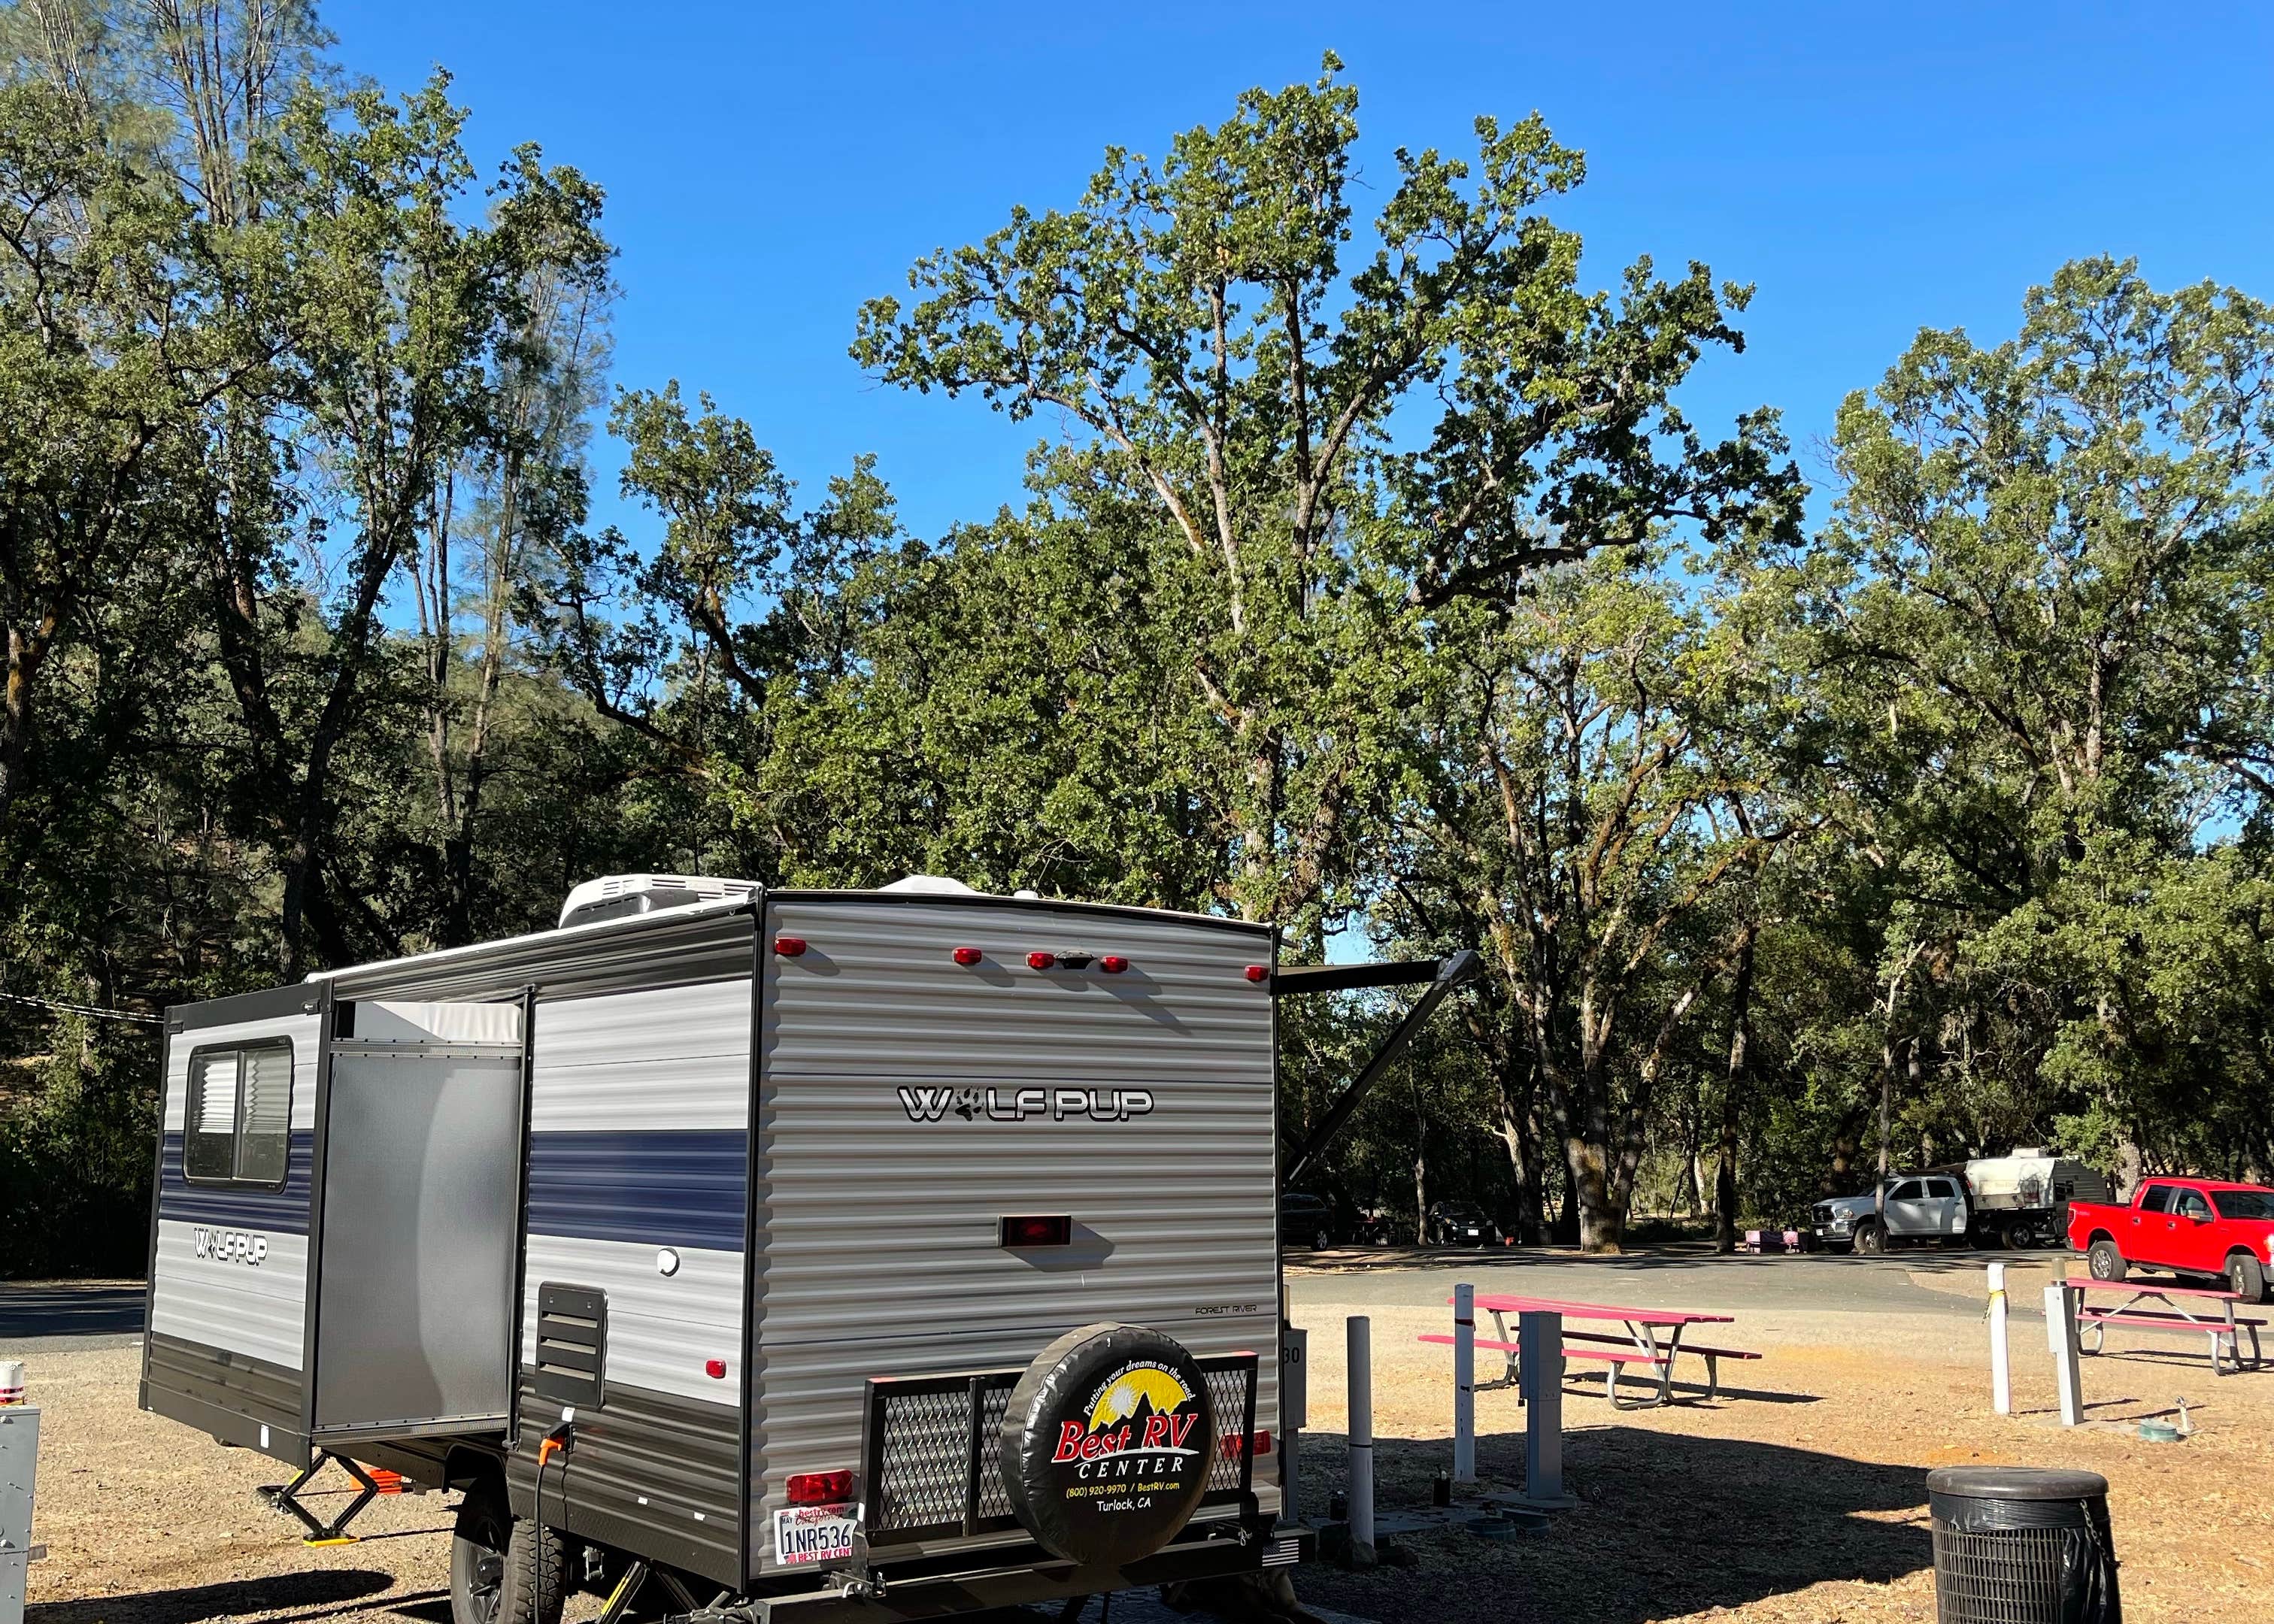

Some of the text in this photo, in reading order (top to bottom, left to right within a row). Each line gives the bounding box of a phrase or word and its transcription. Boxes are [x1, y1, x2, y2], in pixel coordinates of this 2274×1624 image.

[1054, 1088, 1154, 1122] PUP
[235, 1232, 268, 1266] PUP
[1195, 1305, 1229, 1315] FOREST
[1083, 1380, 1108, 1416] Putting
[1105, 1365, 1125, 1386] your
[1126, 1359, 1157, 1371] dreams
[1157, 1363, 1169, 1372] on
[1168, 1367, 1181, 1381] the
[1051, 1413, 1199, 1462] Best RV
[1078, 1456, 1184, 1479] CENTER
[1066, 1487, 1087, 1499] (800)
[1089, 1483, 1126, 1495] 920-9970
[1137, 1481, 1180, 1492] BestRV.com
[1096, 1497, 1151, 1512] Turlock, CA
[785, 1523, 850, 1554] 1NR536
[798, 1551, 819, 1562] BEST
[820, 1549, 832, 1559] RV
